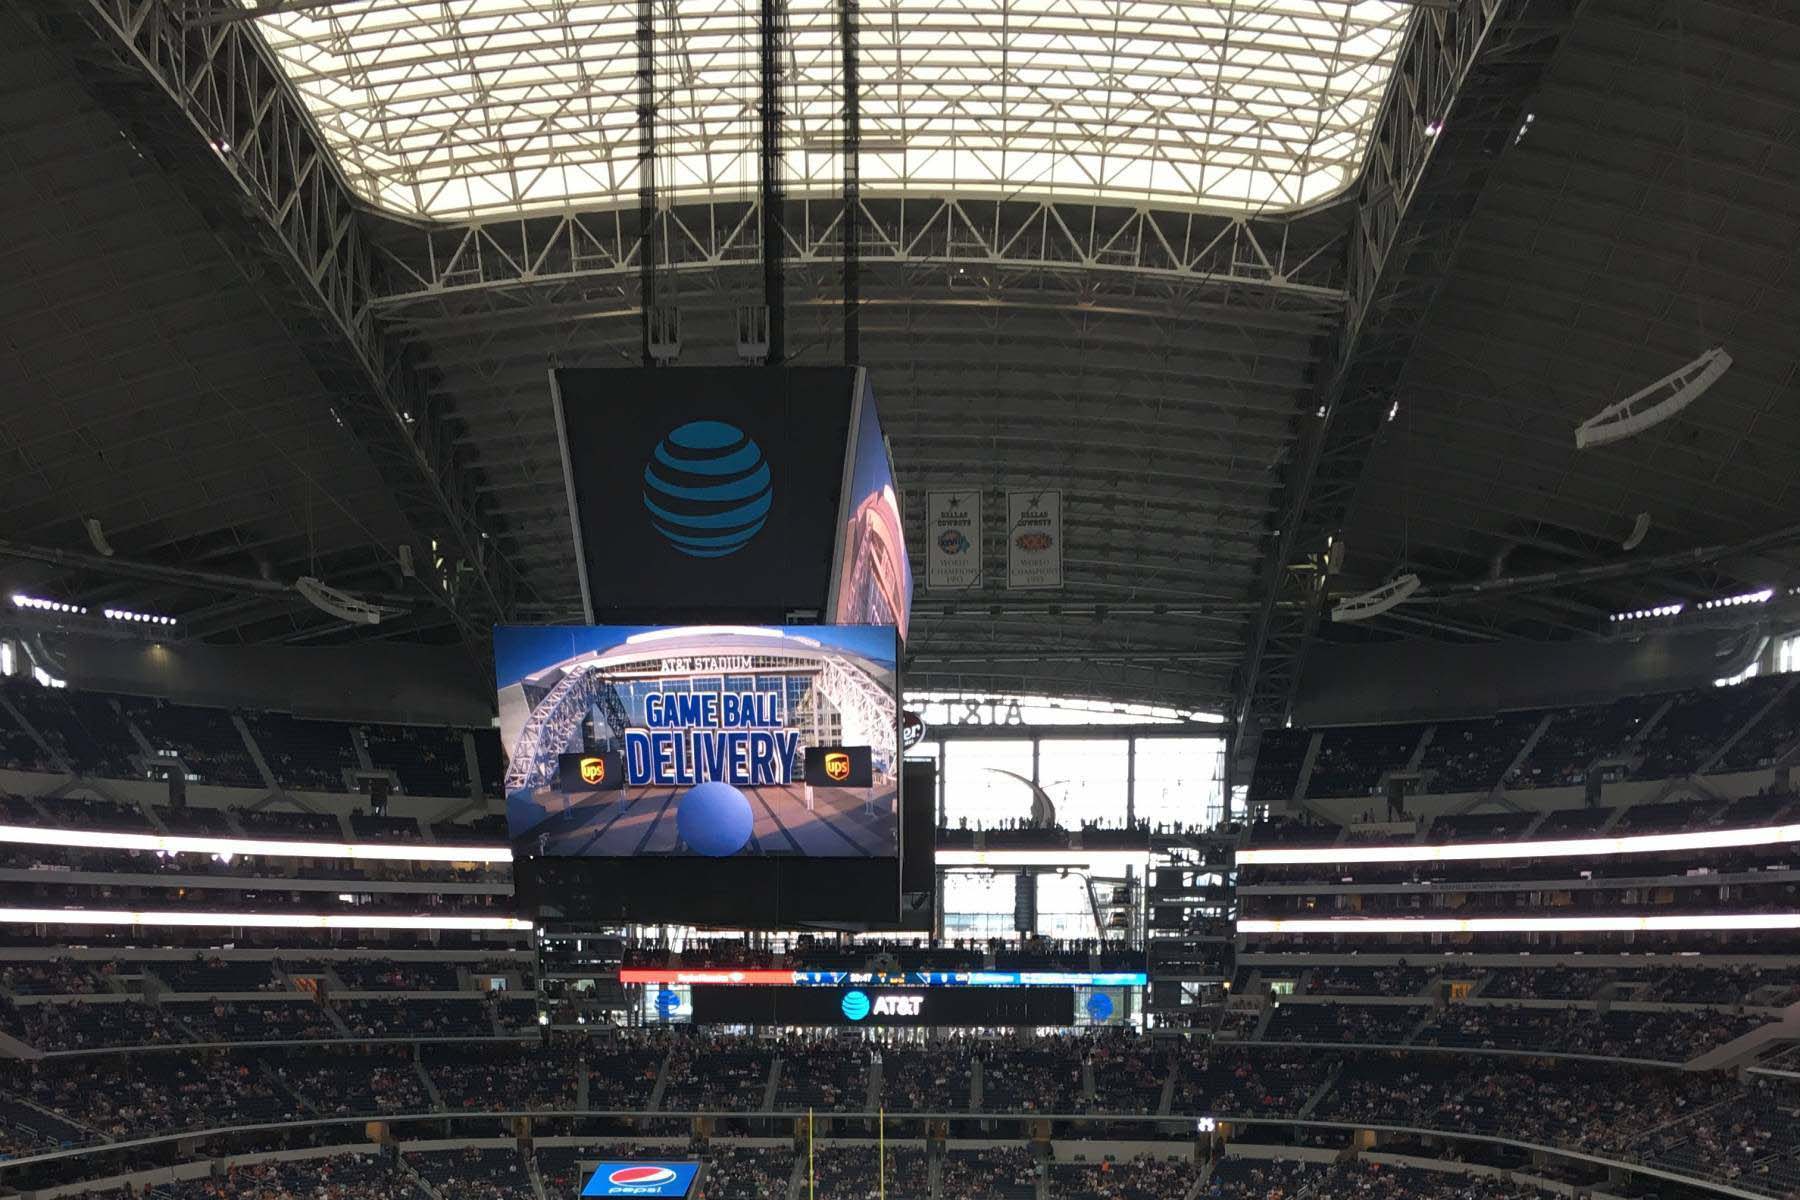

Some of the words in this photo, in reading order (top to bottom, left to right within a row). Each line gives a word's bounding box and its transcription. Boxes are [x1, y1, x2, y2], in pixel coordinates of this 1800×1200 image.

[661, 658, 691, 673] AT&T
[695, 656, 752, 672] STADIUM
[645, 692, 719, 728] GAME
[722, 692, 783, 728] BALL
[625, 729, 799, 785] DELIVERY
[584, 765, 603, 779] ups
[828, 762, 848, 776] ups
[873, 996, 924, 1016] AT&T
